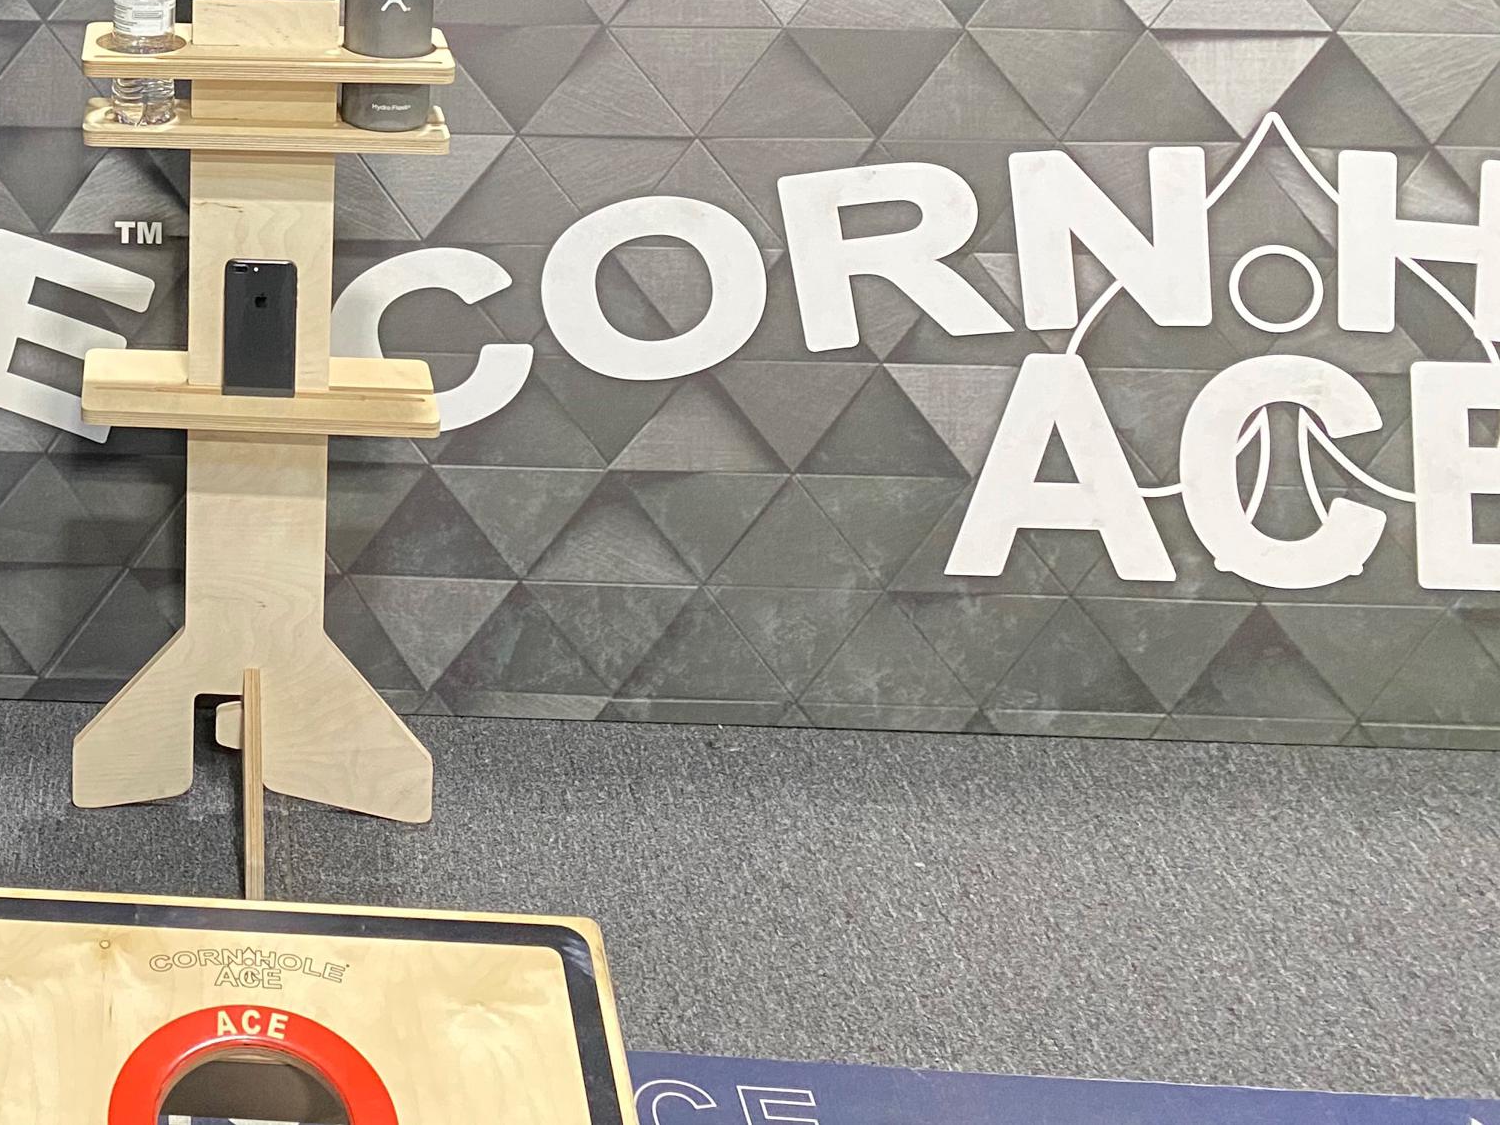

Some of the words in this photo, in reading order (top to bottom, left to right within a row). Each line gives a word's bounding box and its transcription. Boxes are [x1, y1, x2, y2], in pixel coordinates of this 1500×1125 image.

[114, 221, 163, 245] TM
[149, 948, 345, 983] CORNHOLE
[215, 967, 283, 990] ACE
[216, 1009, 289, 1040] ACE
